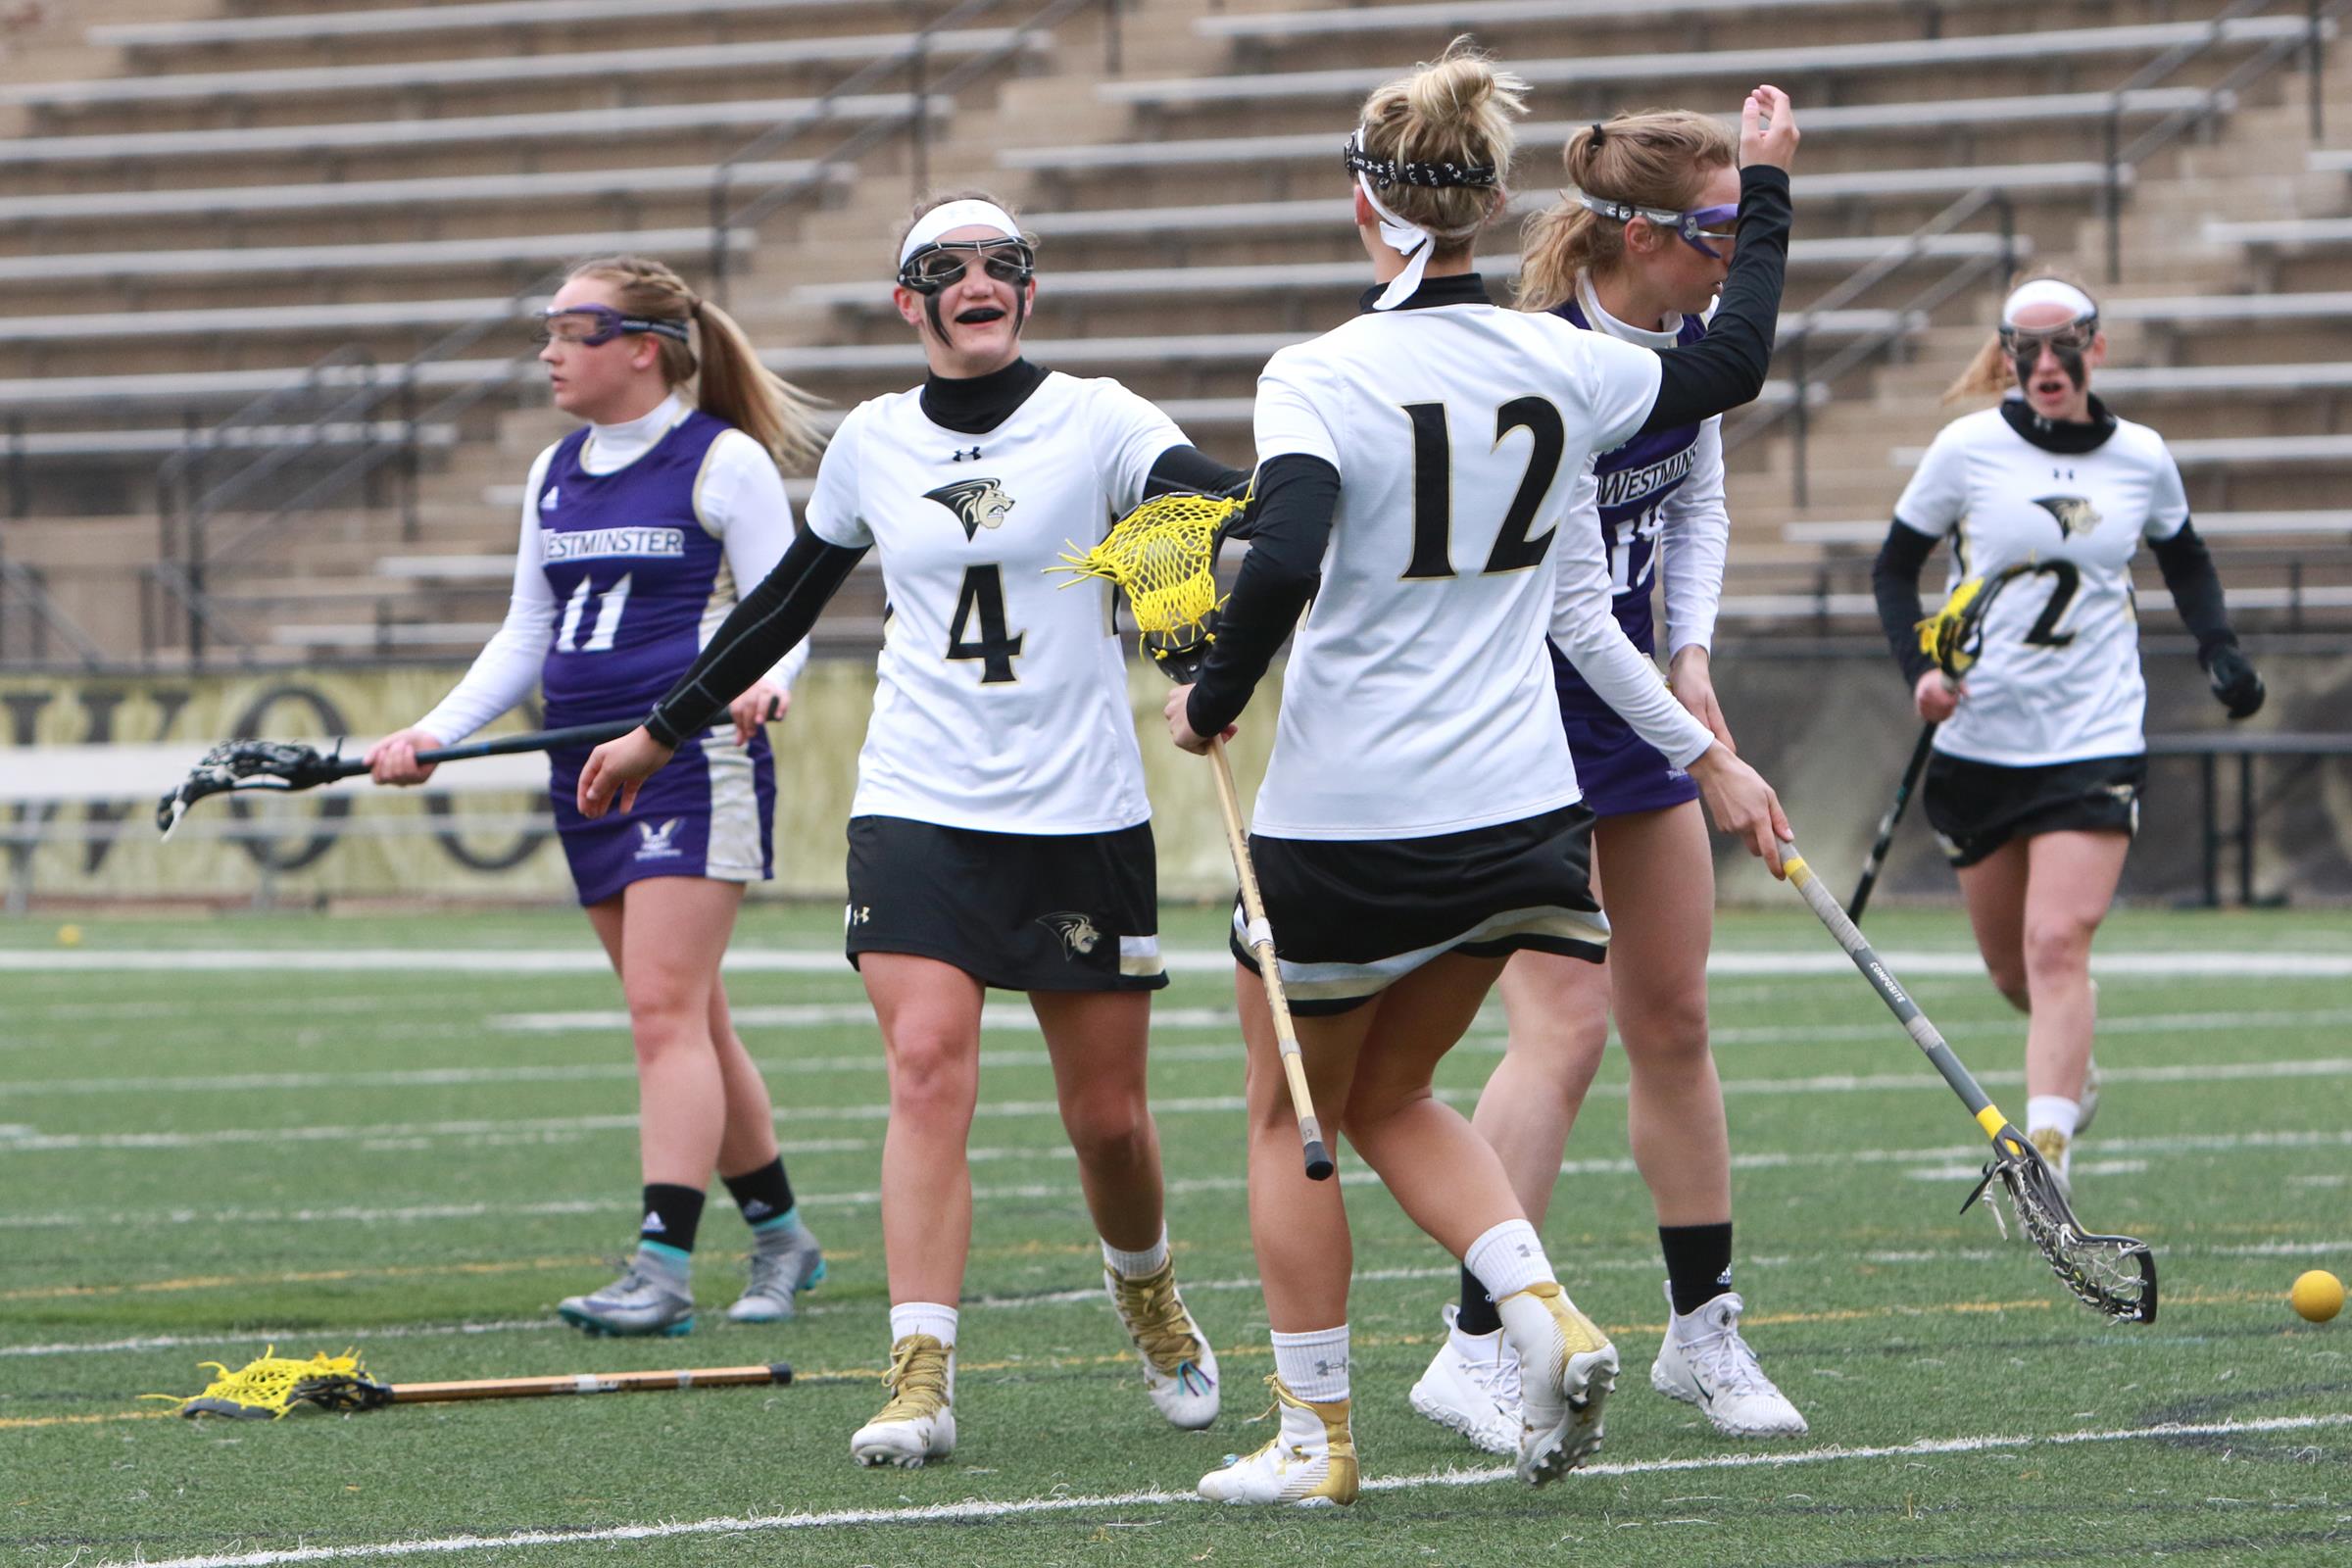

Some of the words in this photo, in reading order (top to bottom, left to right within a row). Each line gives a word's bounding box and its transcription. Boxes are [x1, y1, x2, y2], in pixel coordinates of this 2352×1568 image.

[1396, 393, 1565, 581] 12
[557, 572, 632, 654] 11
[942, 562, 1026, 687] 4
[2021, 558, 2081, 649] 2
[1870, 961, 1906, 1004] COMPOSITE
